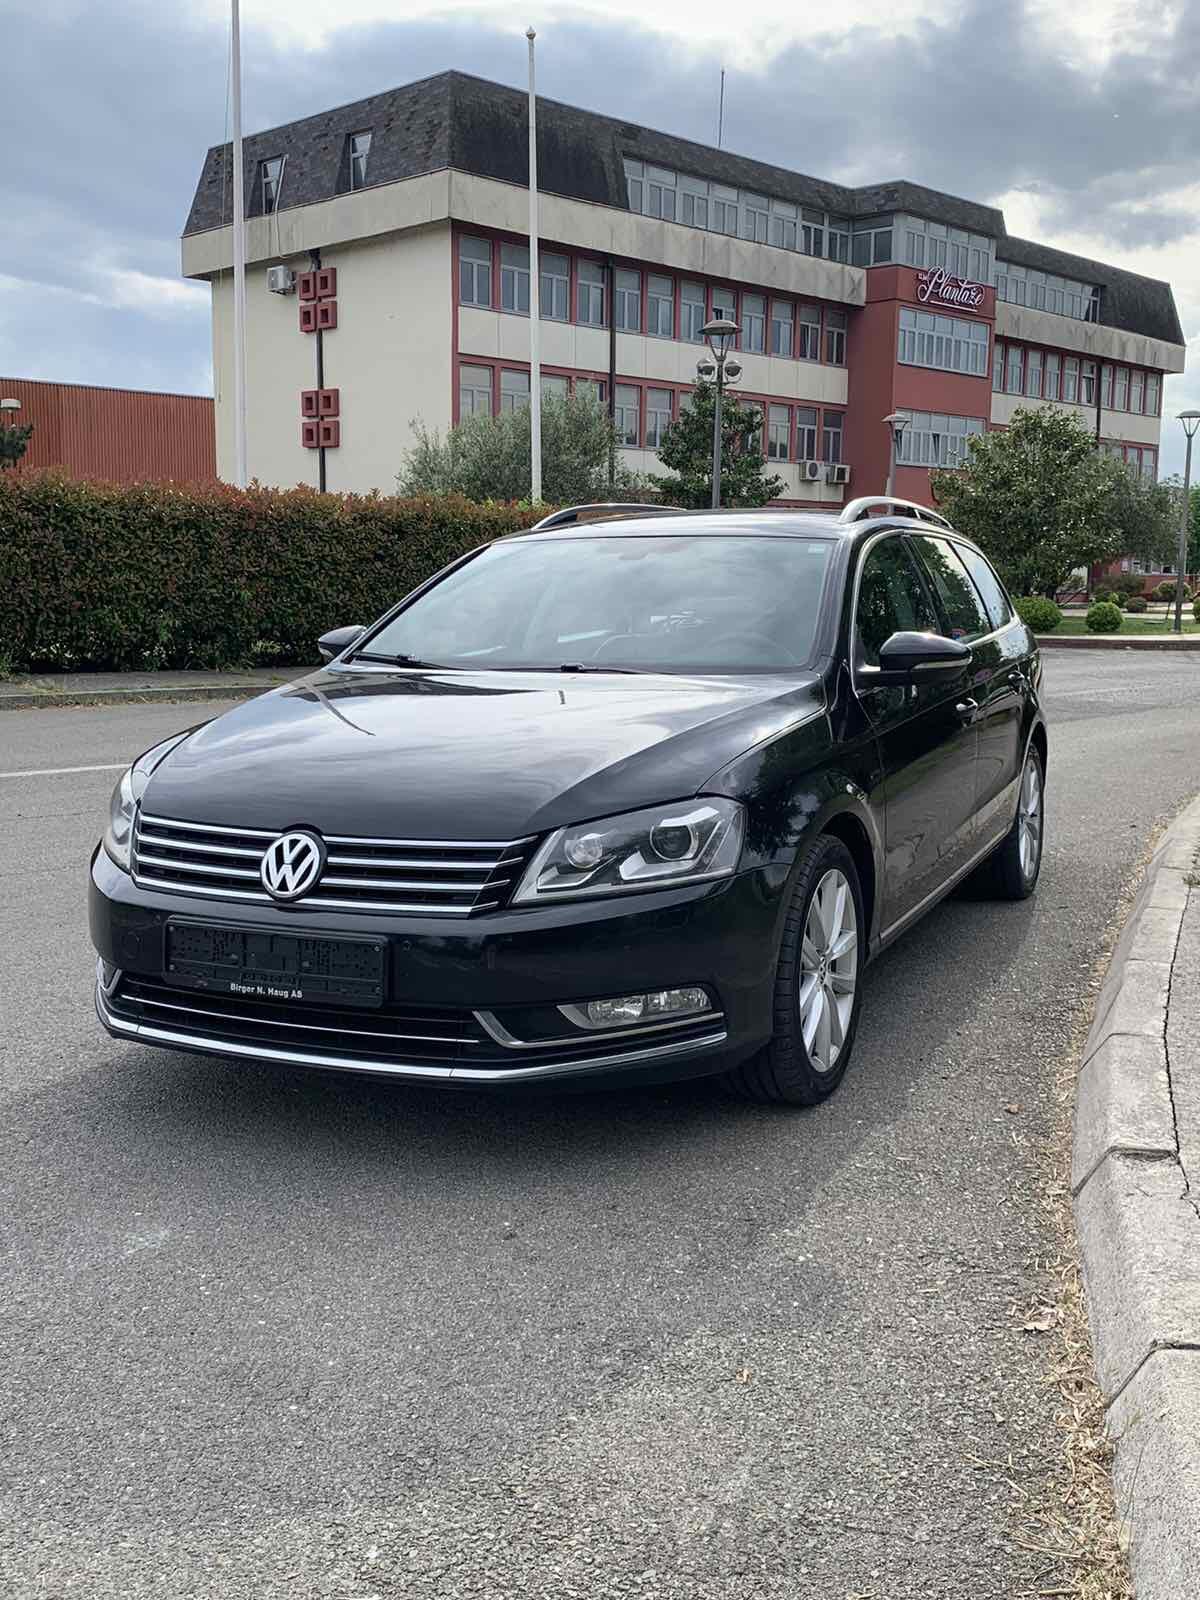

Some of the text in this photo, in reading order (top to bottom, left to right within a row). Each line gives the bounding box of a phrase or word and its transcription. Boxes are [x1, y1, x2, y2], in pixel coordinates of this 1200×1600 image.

[230, 982, 303, 999] Birger N. Haug AS
